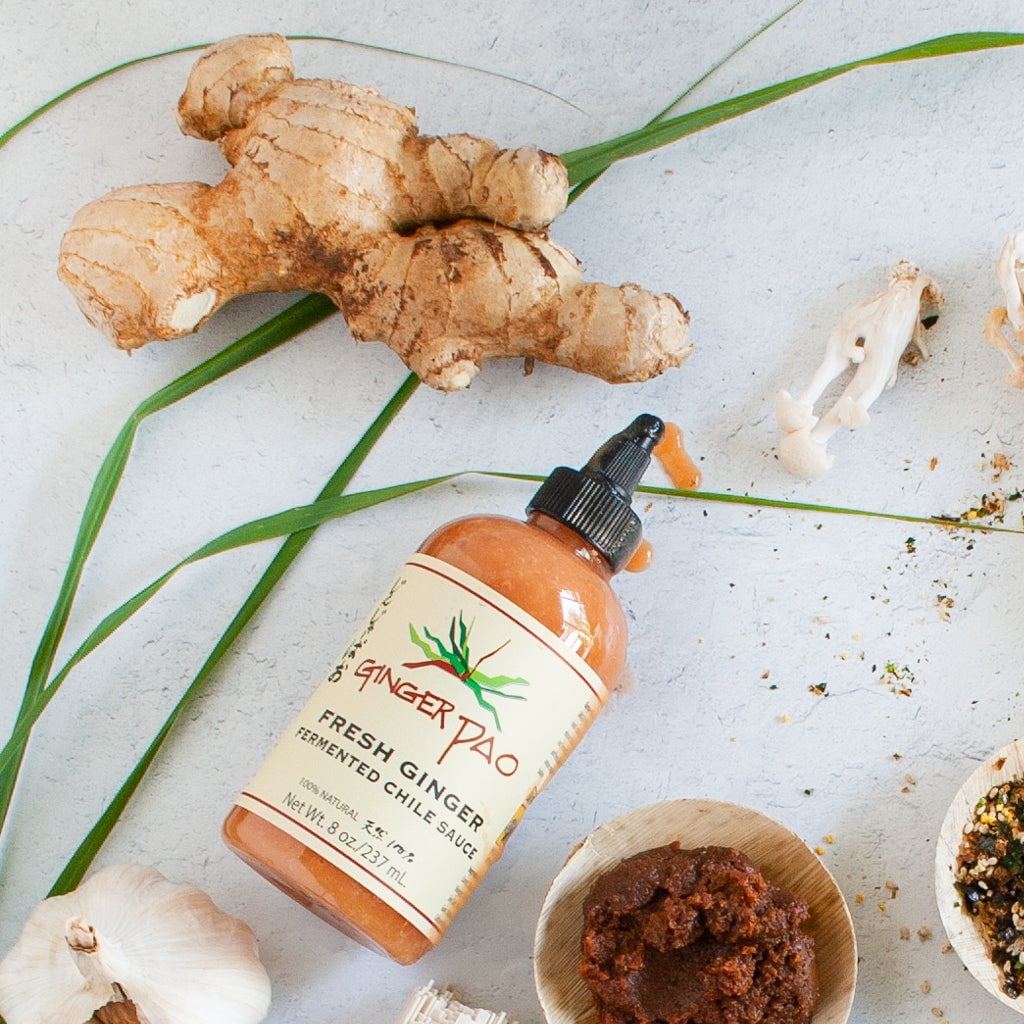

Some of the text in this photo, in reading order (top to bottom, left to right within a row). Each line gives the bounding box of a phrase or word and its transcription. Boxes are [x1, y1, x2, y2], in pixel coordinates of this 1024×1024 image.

[318, 709, 485, 833] FRESH GINGER
[354, 658, 455, 730] GINGER
[437, 715, 519, 777] PAO
[282, 791, 306, 815] Net
[305, 803, 326, 829] Wt.
[327, 821, 340, 835] 8
[295, 726, 479, 861] FERMENTED CHILE SAUCE
[298, 777, 361, 823] 100% NATURAL
